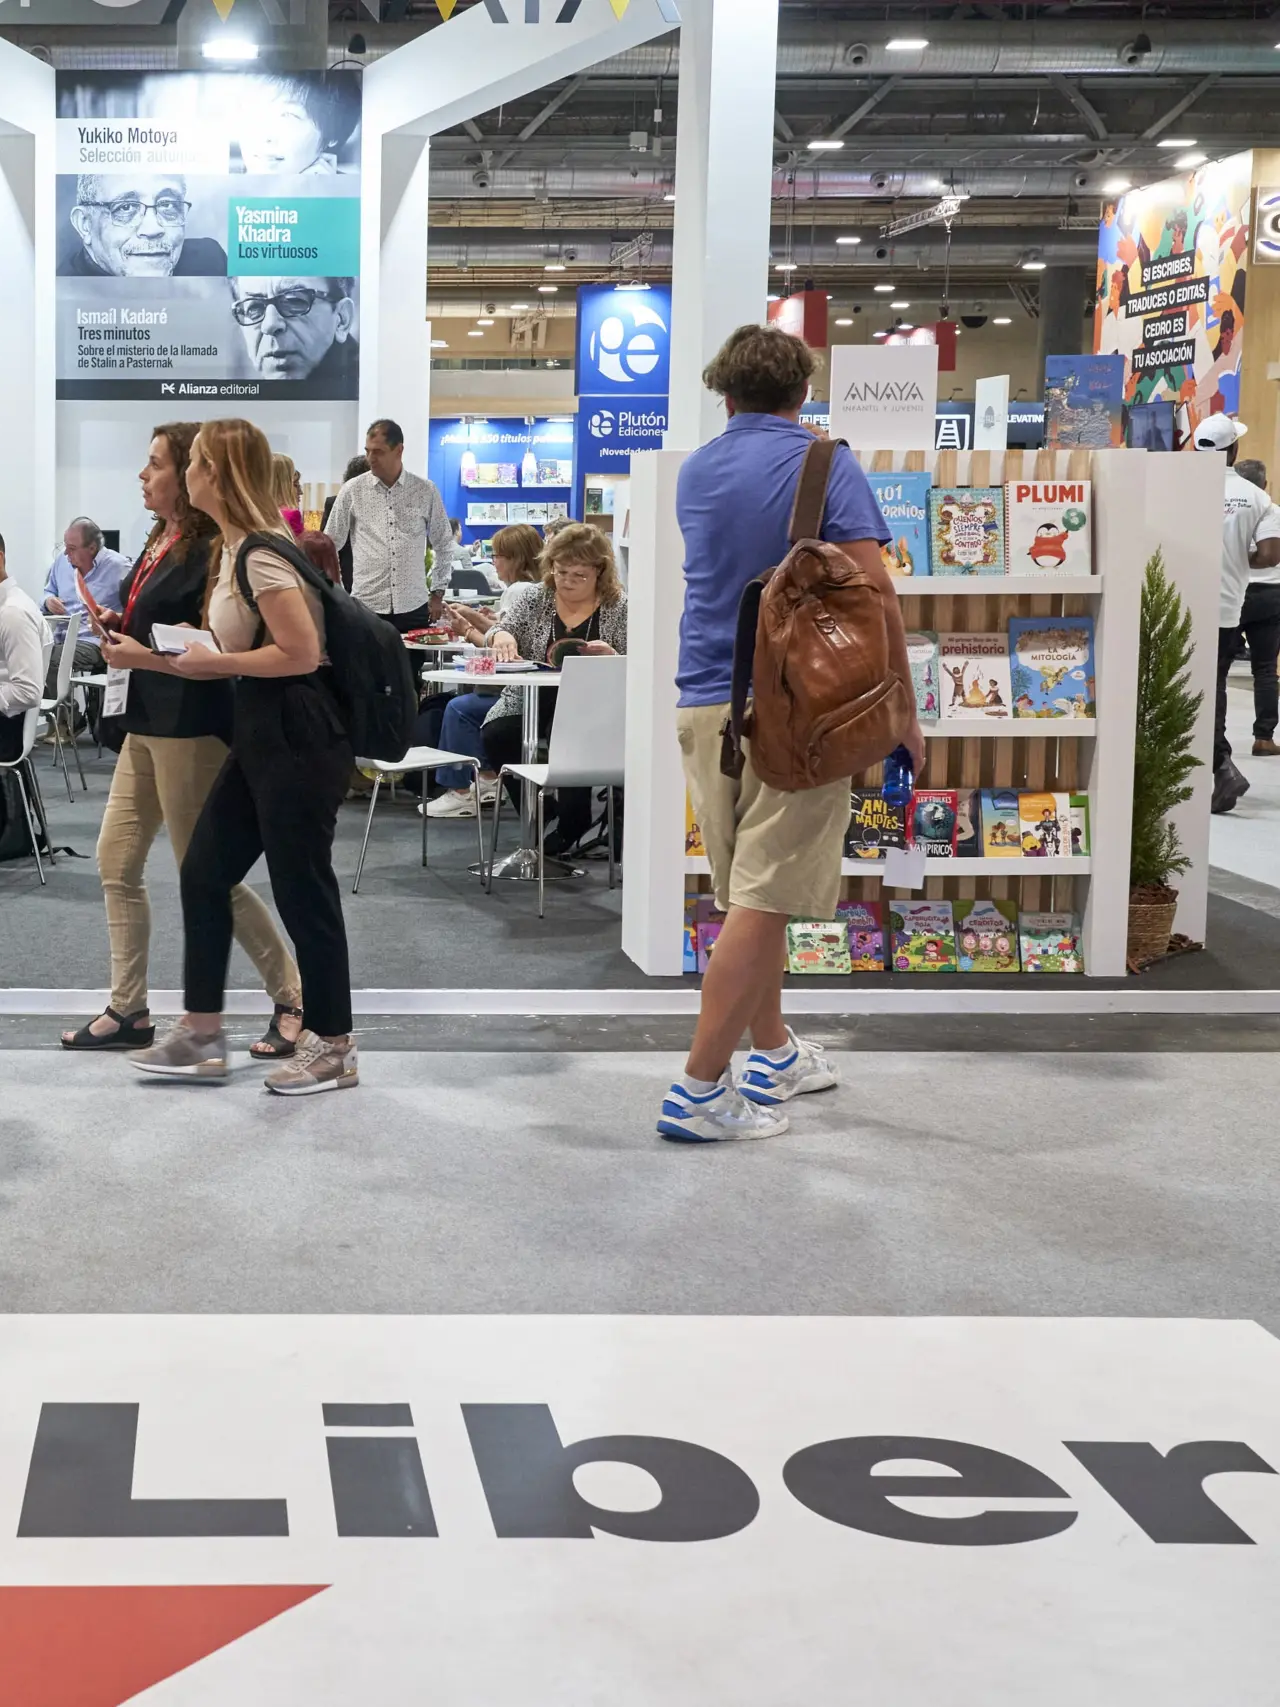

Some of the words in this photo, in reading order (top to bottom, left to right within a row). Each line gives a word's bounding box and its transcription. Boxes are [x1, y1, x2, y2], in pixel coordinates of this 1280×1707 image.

[78, 127, 123, 144] Yukiko
[128, 127, 178, 146] Motoya
[79, 147, 142, 164] Selección
[236, 206, 298, 224] Yasmina
[238, 225, 291, 243] Khadra
[238, 244, 260, 259] Los
[261, 244, 318, 259] virtuosos
[1143, 268, 1151, 283] SI
[1152, 257, 1193, 281] ESCRIBES,
[1127, 290, 1168, 314] TRADUCES
[1169, 290, 1176, 304] O
[1177, 283, 1207, 303] EDITAS,
[120, 308, 168, 324] Kadaré
[78, 327, 101, 341] Tres
[103, 327, 150, 341] minutos
[1145, 320, 1171, 339] CEDRO
[1172, 317, 1184, 333] ES
[78, 345, 104, 356] Sobre
[106, 345, 115, 356] el
[116, 345, 154, 356] misterio
[157, 345, 168, 356] de
[170, 345, 179, 356] la
[180, 345, 218, 356] llamada
[1134, 353, 1145, 369] TU
[1145, 343, 1193, 366] ASOCIACIÓN
[78, 357, 89, 369] de
[91, 357, 117, 369] Stalin
[119, 360, 125, 369] a
[127, 357, 173, 369] Pasternak
[179, 383, 218, 394] Alianza
[220, 383, 260, 395] editorial
[844, 382, 924, 401] ANAYA
[619, 411, 666, 426] Plutón
[619, 427, 665, 436] Ediciones
[876, 484, 903, 503] 101
[1016, 485, 1084, 503] PLUMI
[942, 644, 1005, 656] prehistoria
[1031, 653, 1077, 661] MITOLOGÍA
[861, 799, 888, 814] ANI
[856, 813, 899, 830] MALOTES
[16, 1401, 1279, 1546] Liber
